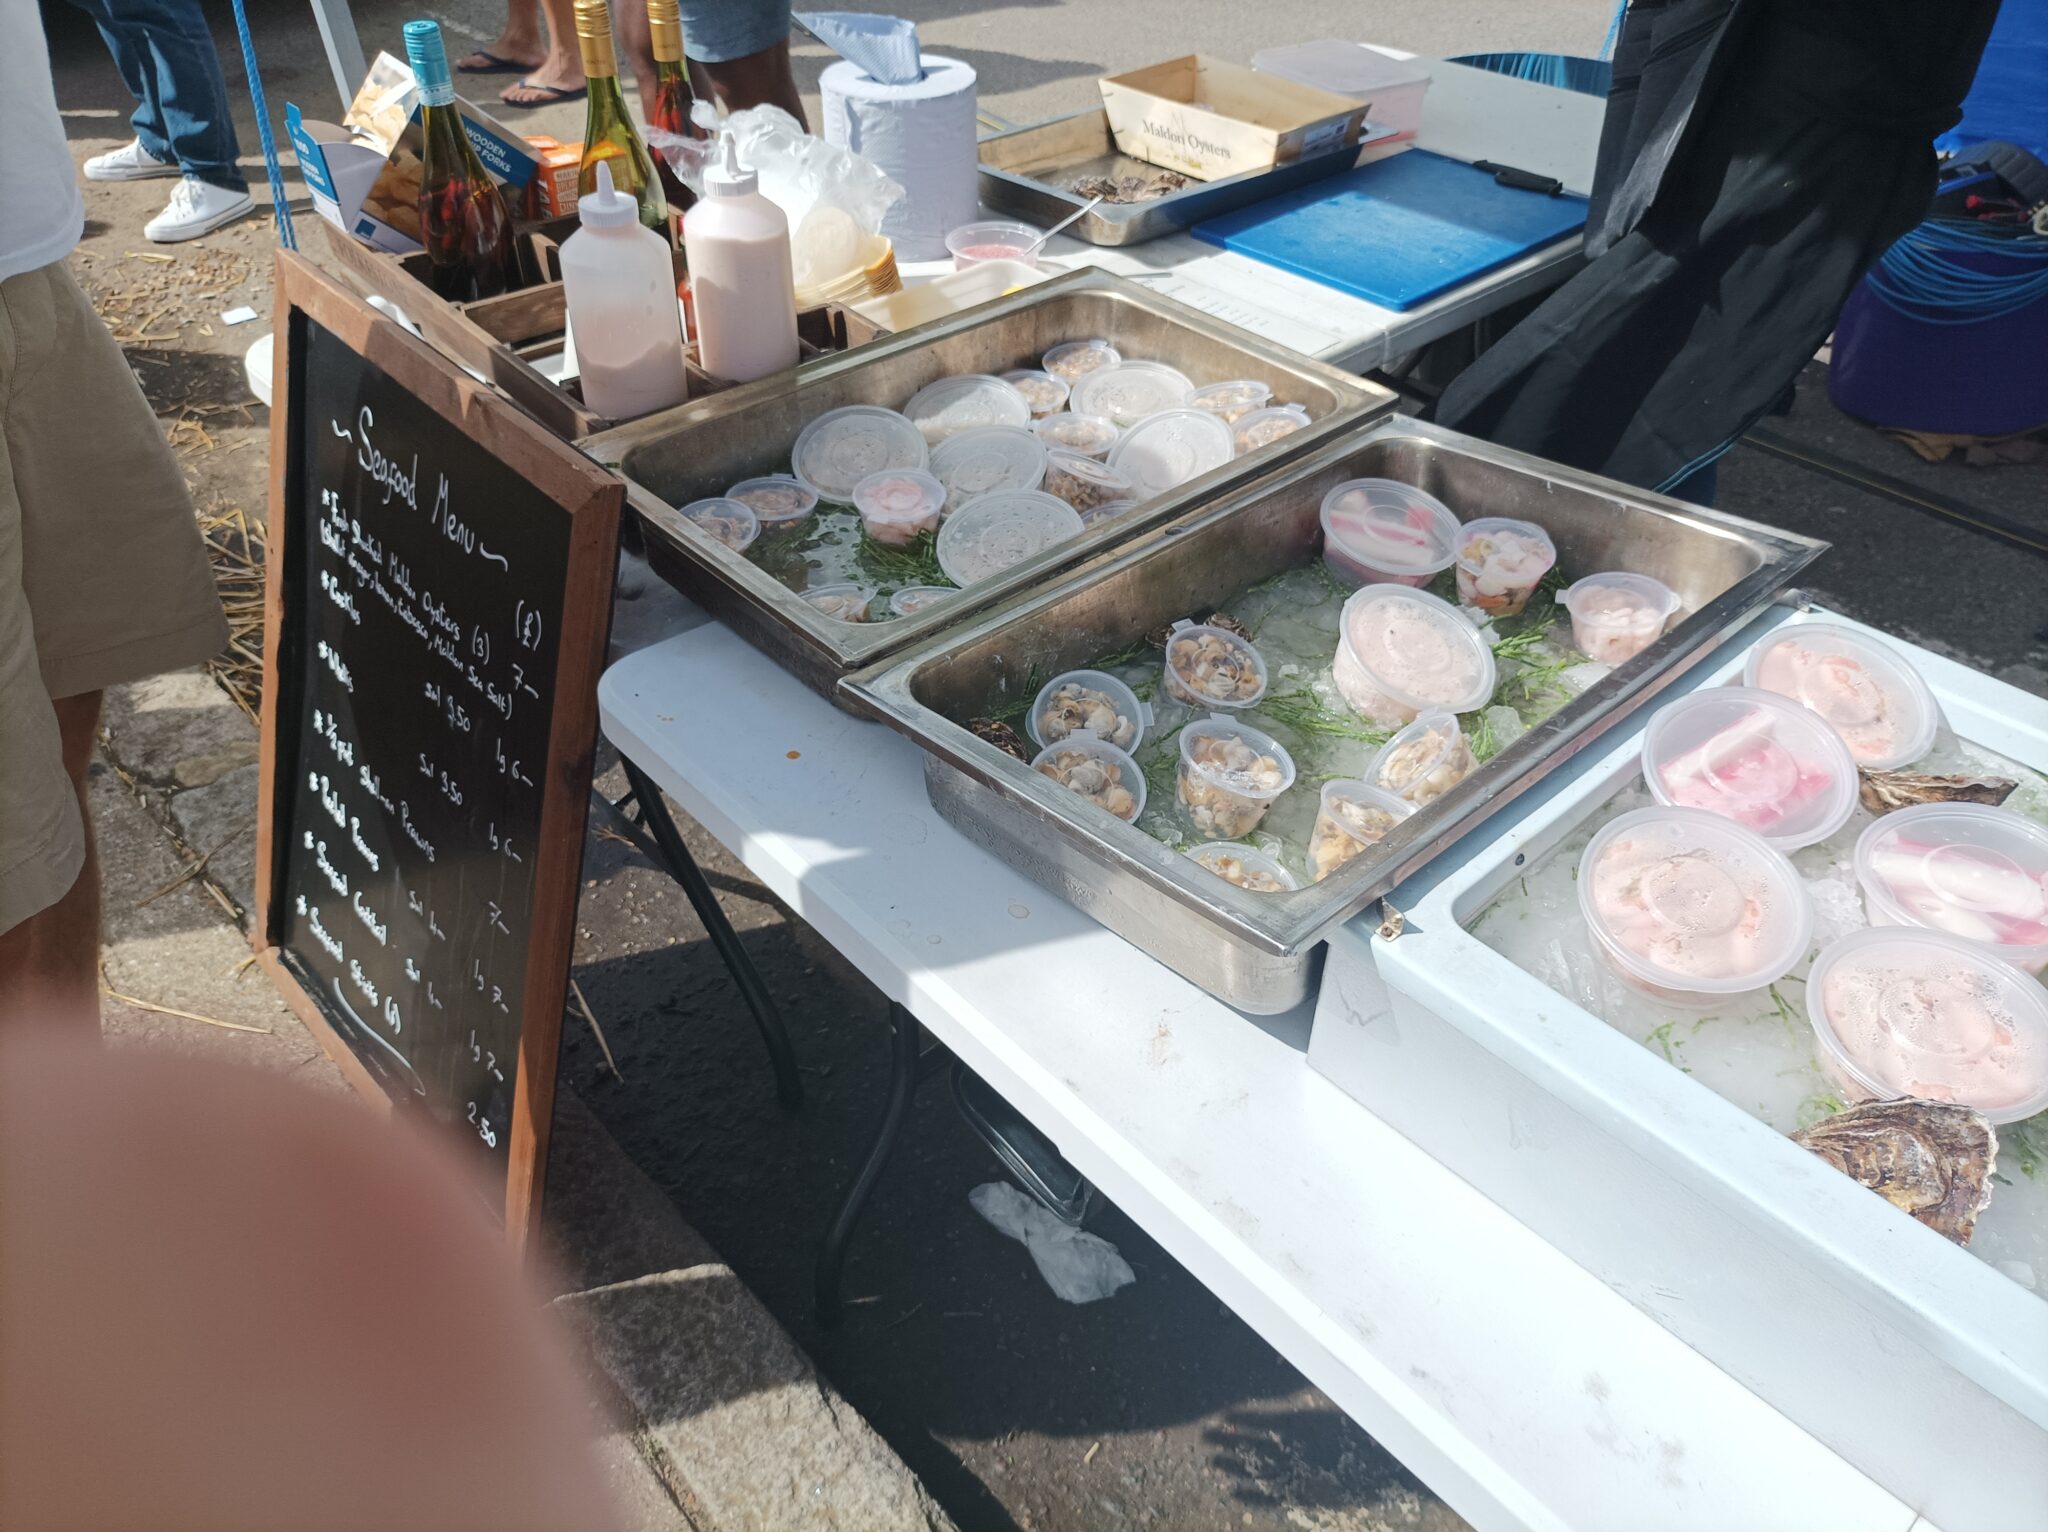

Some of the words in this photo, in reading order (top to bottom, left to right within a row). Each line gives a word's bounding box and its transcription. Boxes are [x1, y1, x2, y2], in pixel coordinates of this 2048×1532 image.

[466, 127, 506, 158] WOODEN
[481, 149, 511, 172] FORKS
[1143, 119, 1185, 145] Maldon
[1188, 134, 1231, 159] Oysters
[358, 405, 418, 511] Seafood
[432, 472, 475, 554] Menu
[389, 552, 416, 601] Maldon
[423, 591, 460, 641] Oysters
[472, 625, 490, 665] (3)
[434, 634, 463, 672] Maldon
[468, 665, 483, 692] Sea
[487, 682, 512, 720] Salt)
[441, 770, 463, 805] 3.50
[401, 800, 435, 862] Prawns
[467, 1101, 497, 1148] 2.50
